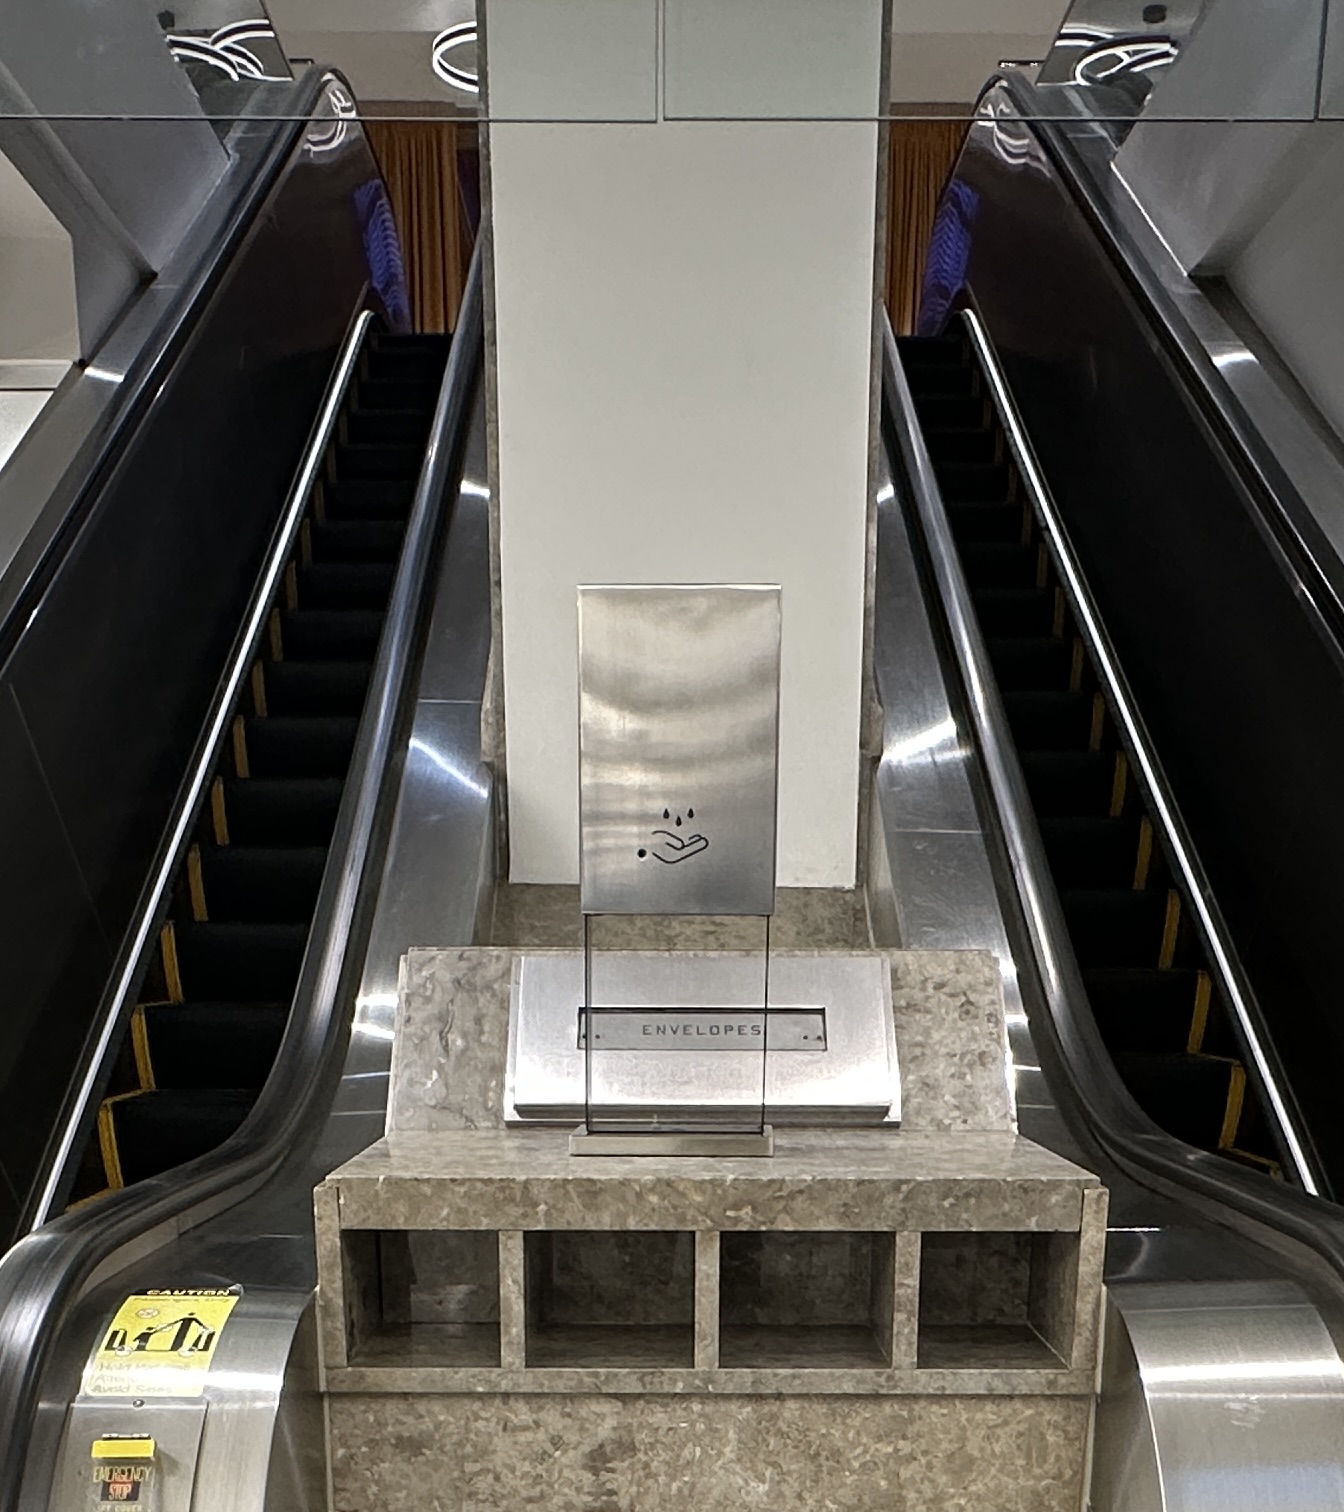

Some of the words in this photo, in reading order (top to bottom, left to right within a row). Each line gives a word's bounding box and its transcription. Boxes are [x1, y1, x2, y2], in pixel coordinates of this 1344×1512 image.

[642, 1024, 762, 1036] ENVELOPES
[146, 1289, 230, 1297] CAUTION
[92, 1466, 153, 1483] EMERGENCY
[108, 1484, 132, 1501] STOP
